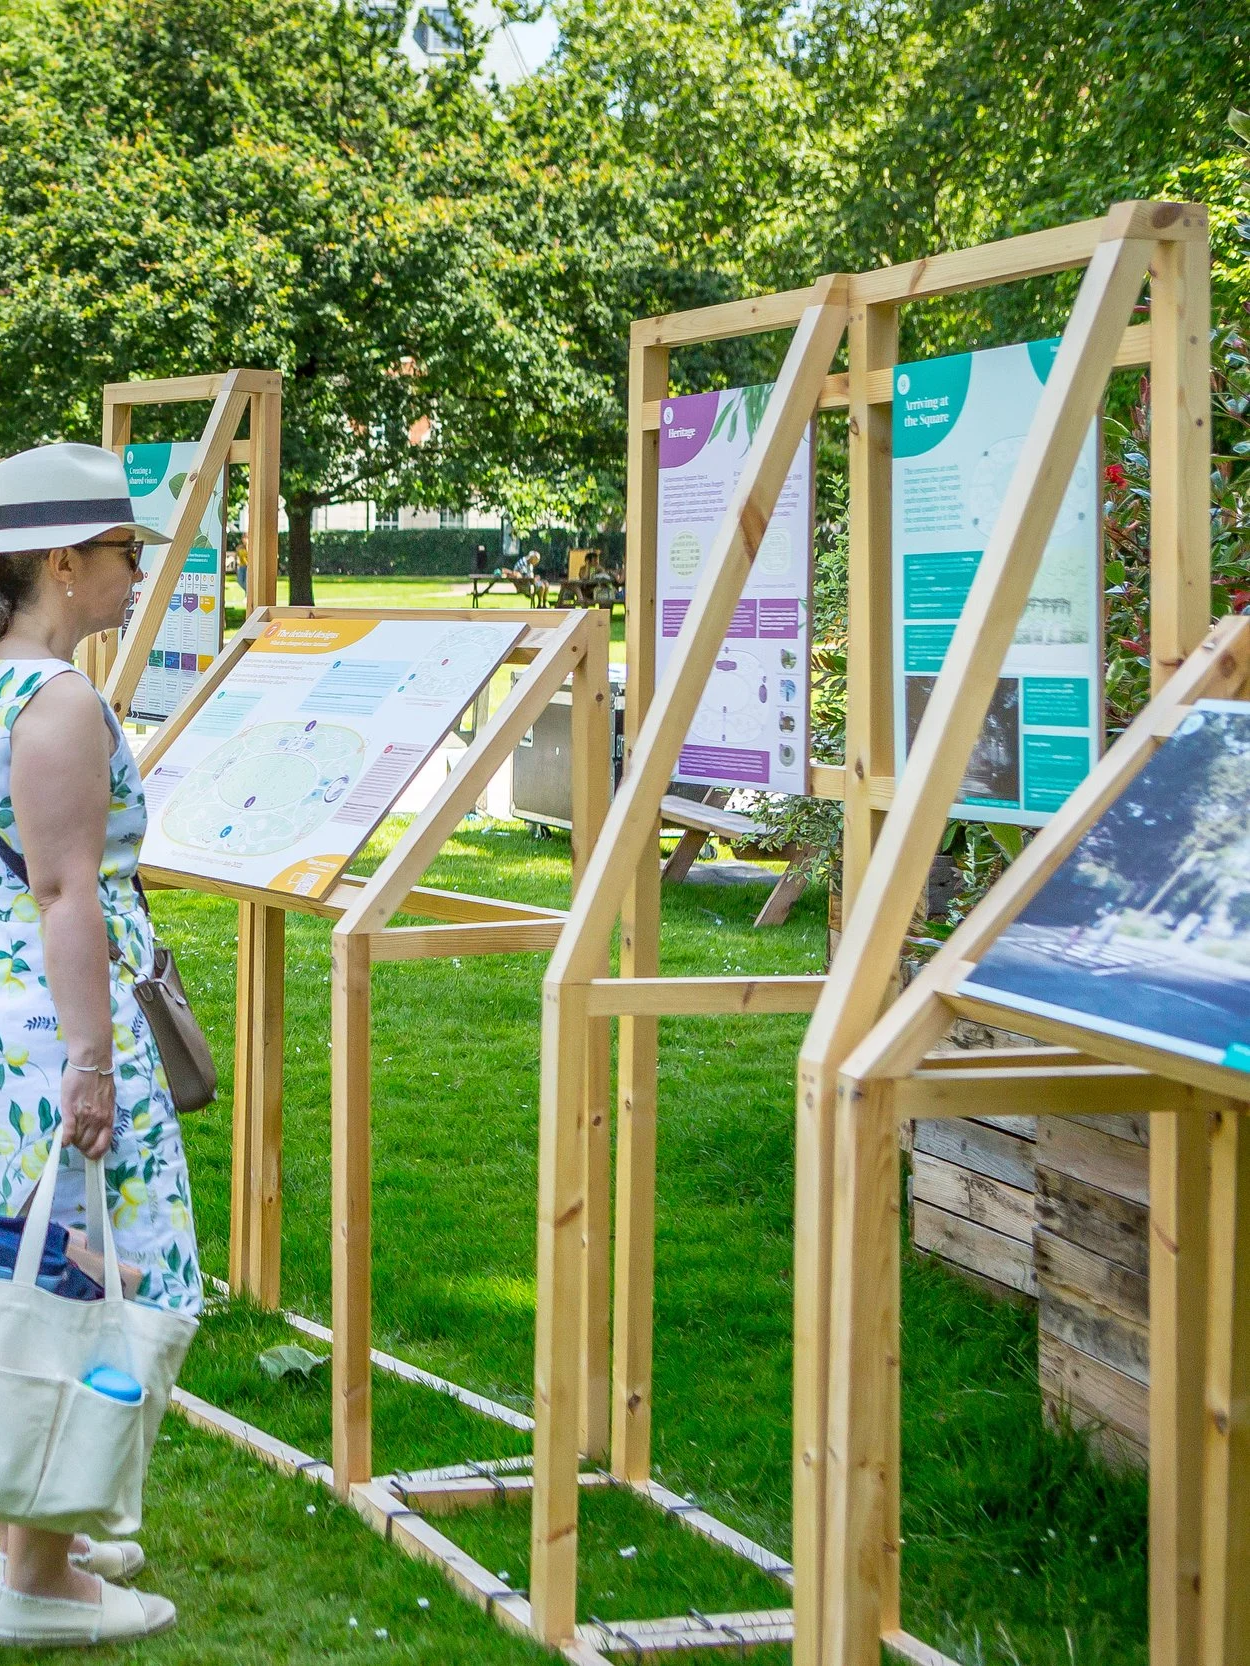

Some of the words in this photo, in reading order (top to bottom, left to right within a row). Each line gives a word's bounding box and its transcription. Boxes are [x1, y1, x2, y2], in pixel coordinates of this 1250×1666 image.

[905, 397, 938, 410] Arriving
[940, 395, 949, 406] at
[904, 415, 918, 427] the
[919, 414, 949, 427] Square
[668, 427, 696, 440] Heritage
[130, 467, 148, 476] Creating
[278, 630, 288, 638] The
[288, 630, 313, 639] detailed
[313, 630, 340, 641] designs
